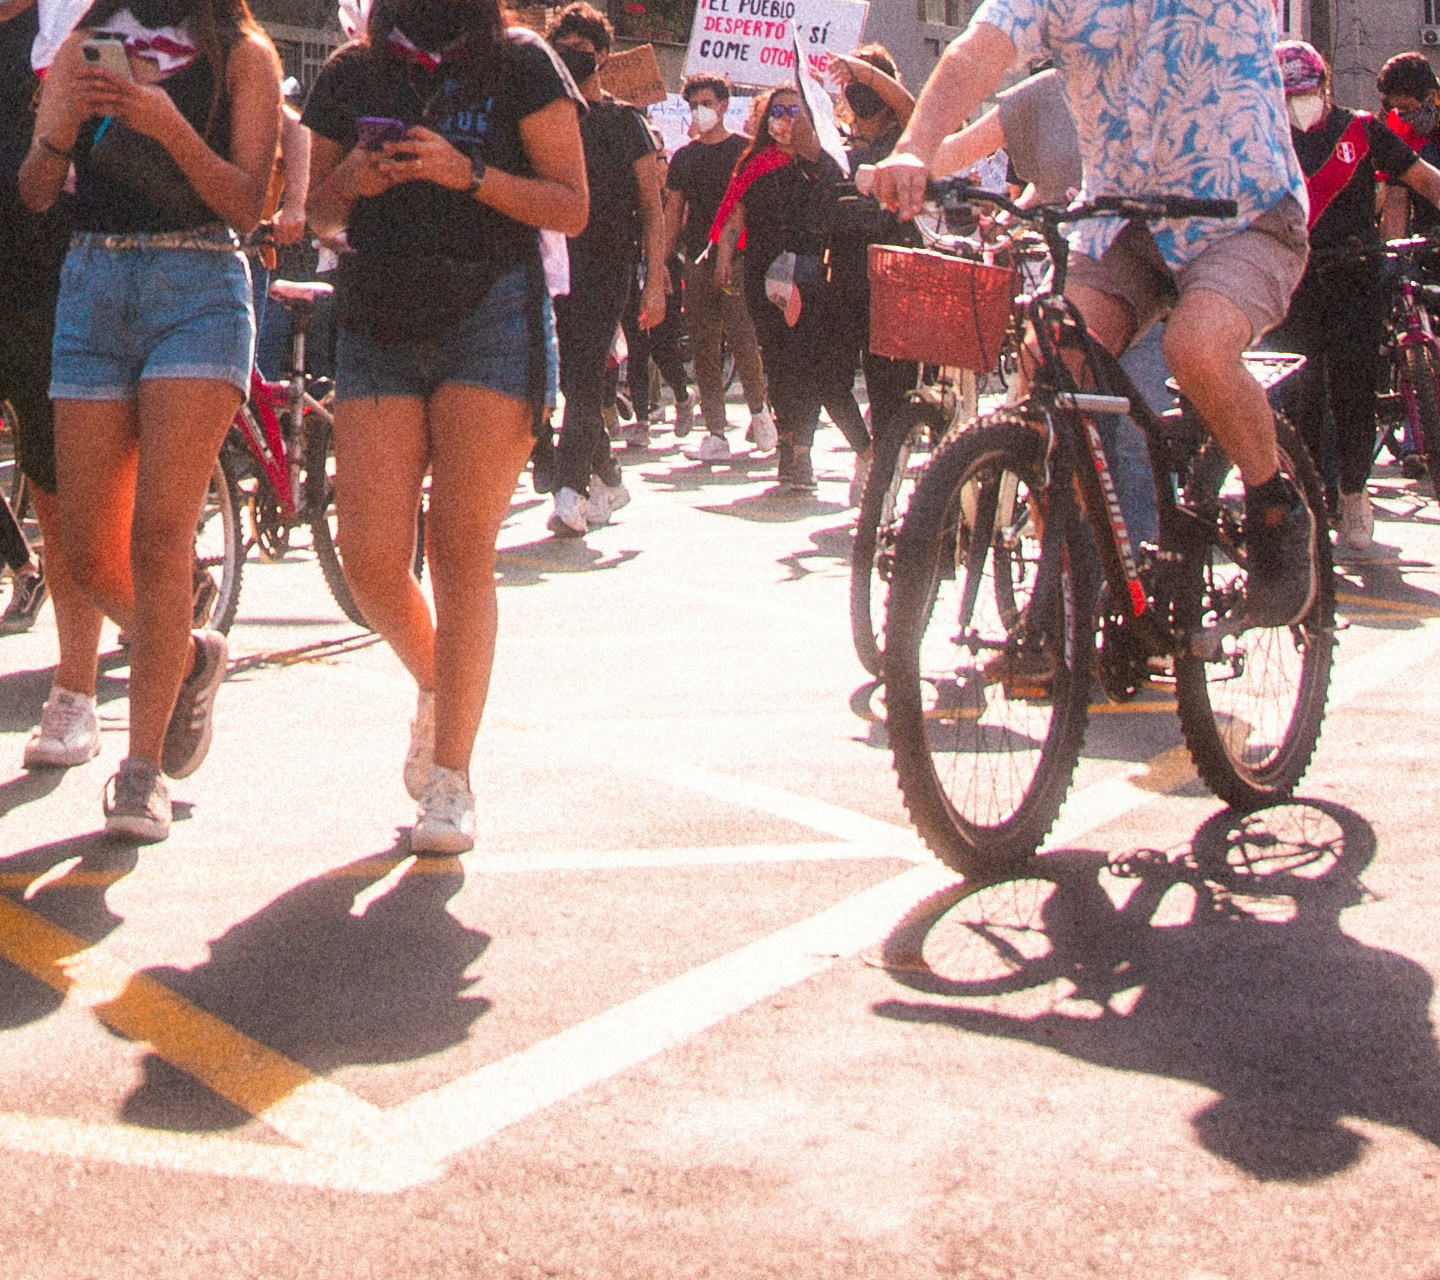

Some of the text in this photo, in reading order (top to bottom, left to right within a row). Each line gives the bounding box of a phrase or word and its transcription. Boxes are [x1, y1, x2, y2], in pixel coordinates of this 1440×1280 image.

[704, 16, 831, 45] DESPERTÓ SÍ
[699, 39, 750, 62] COME
